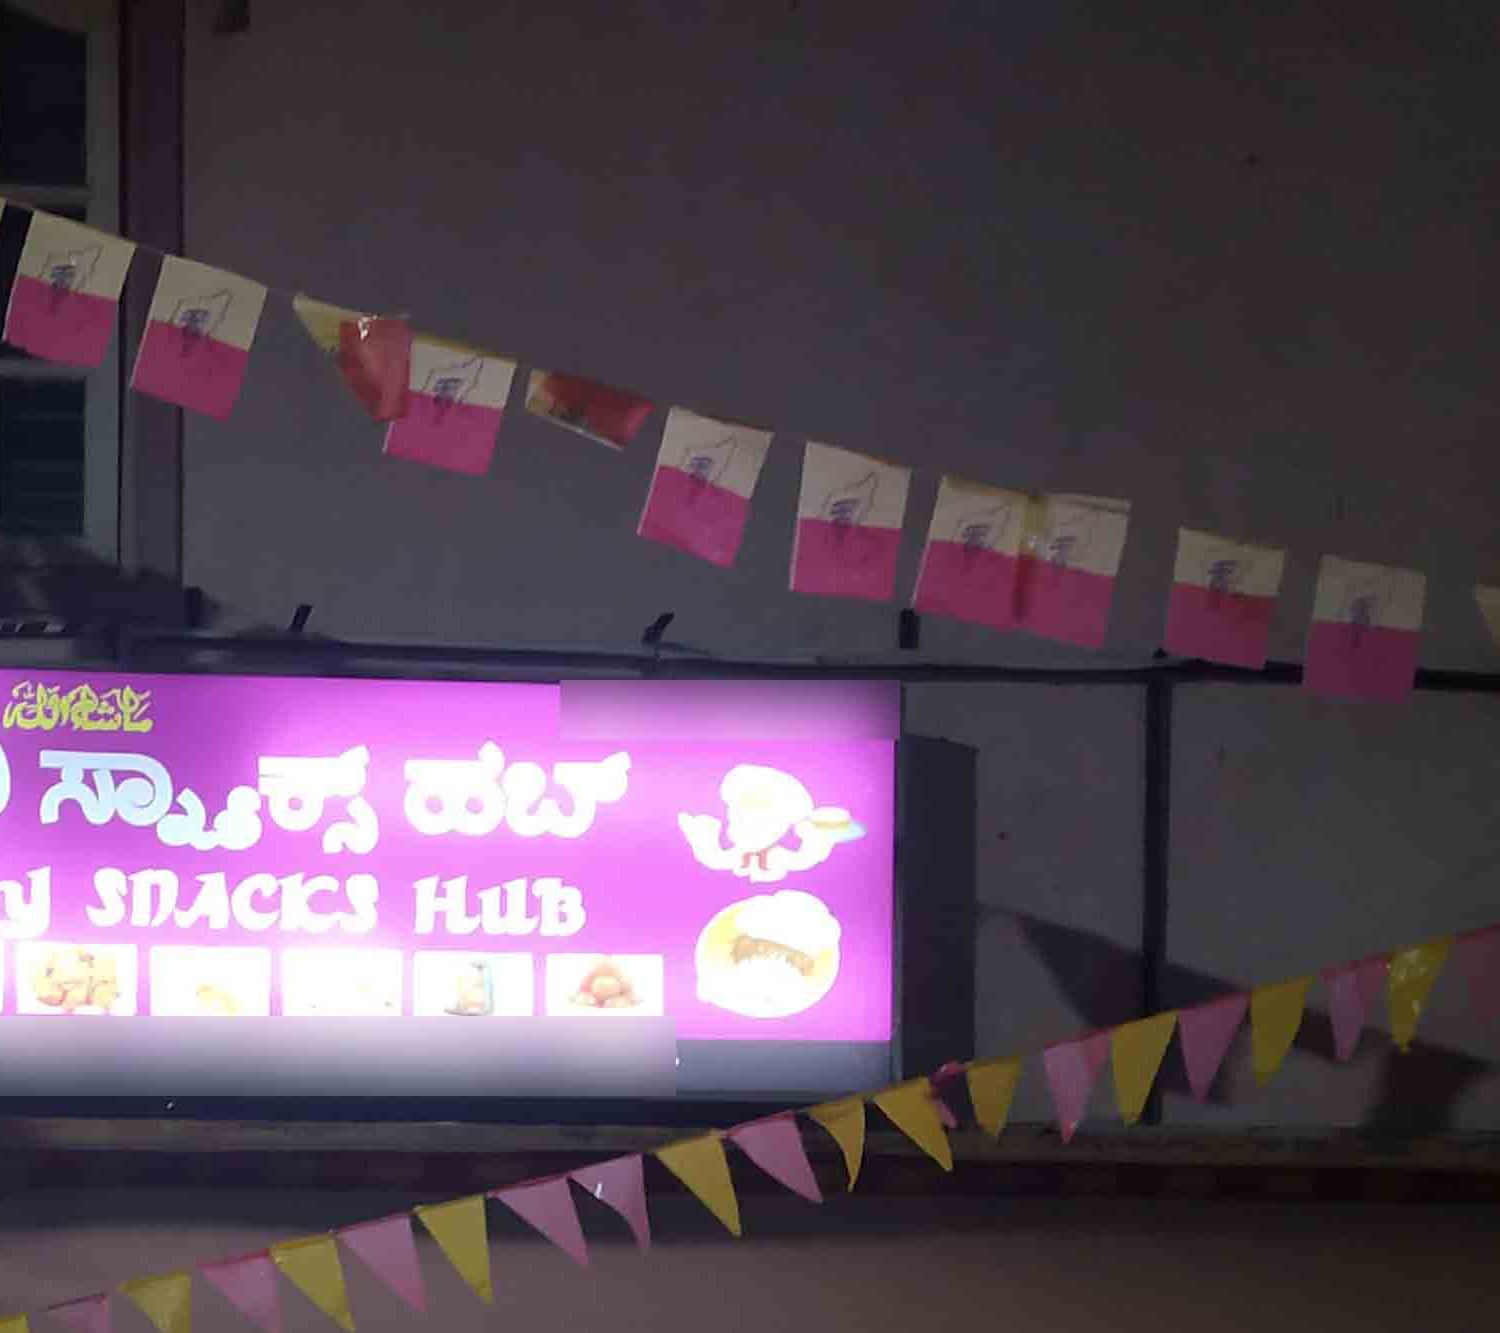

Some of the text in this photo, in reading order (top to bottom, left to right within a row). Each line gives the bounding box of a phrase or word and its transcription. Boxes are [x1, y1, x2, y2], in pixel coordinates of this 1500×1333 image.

[403, 739, 633, 839] ಹಬ್
[84, 866, 380, 933] SNACKS
[411, 874, 587, 937] HUB
